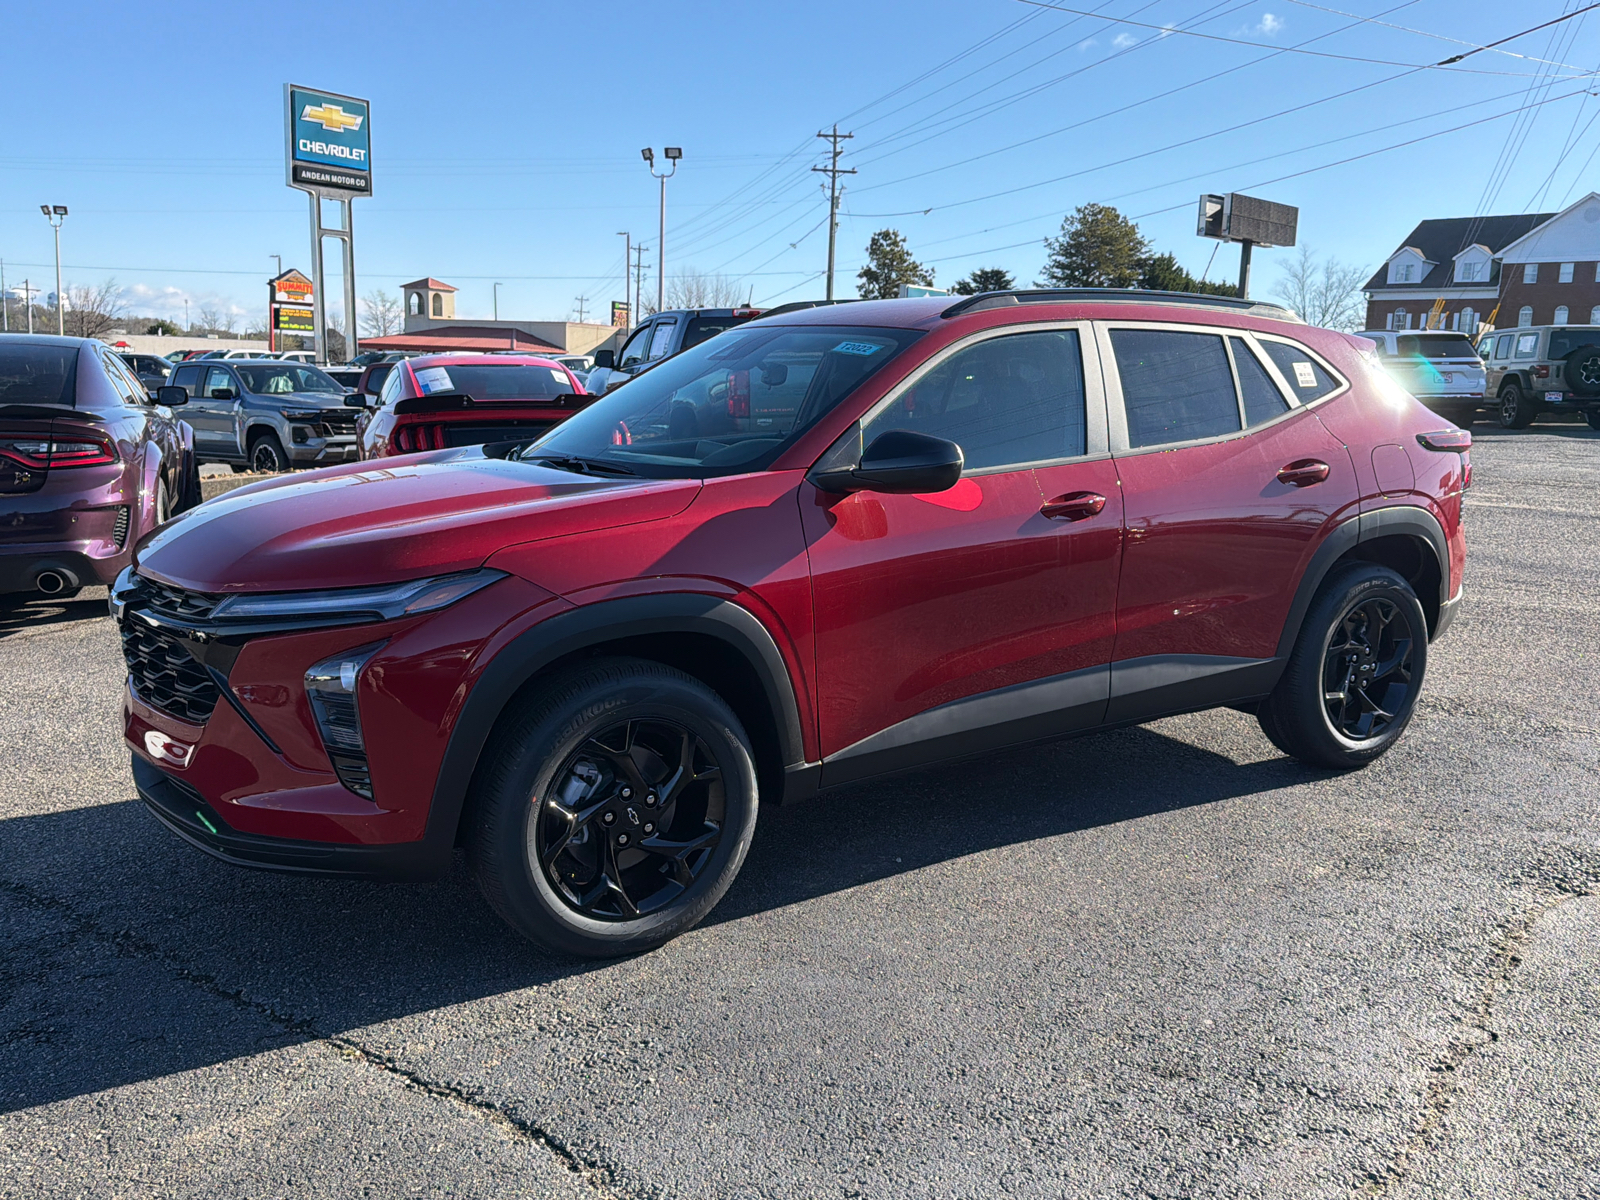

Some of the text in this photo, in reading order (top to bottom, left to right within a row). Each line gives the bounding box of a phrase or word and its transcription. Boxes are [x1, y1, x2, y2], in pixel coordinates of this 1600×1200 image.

[299, 139, 366, 161] CHEVROLET
[301, 170, 366, 187] ANDEAN MOTOR CO
[841, 343, 872, 352] T2022
[724, 727, 739, 748] Kontrol
